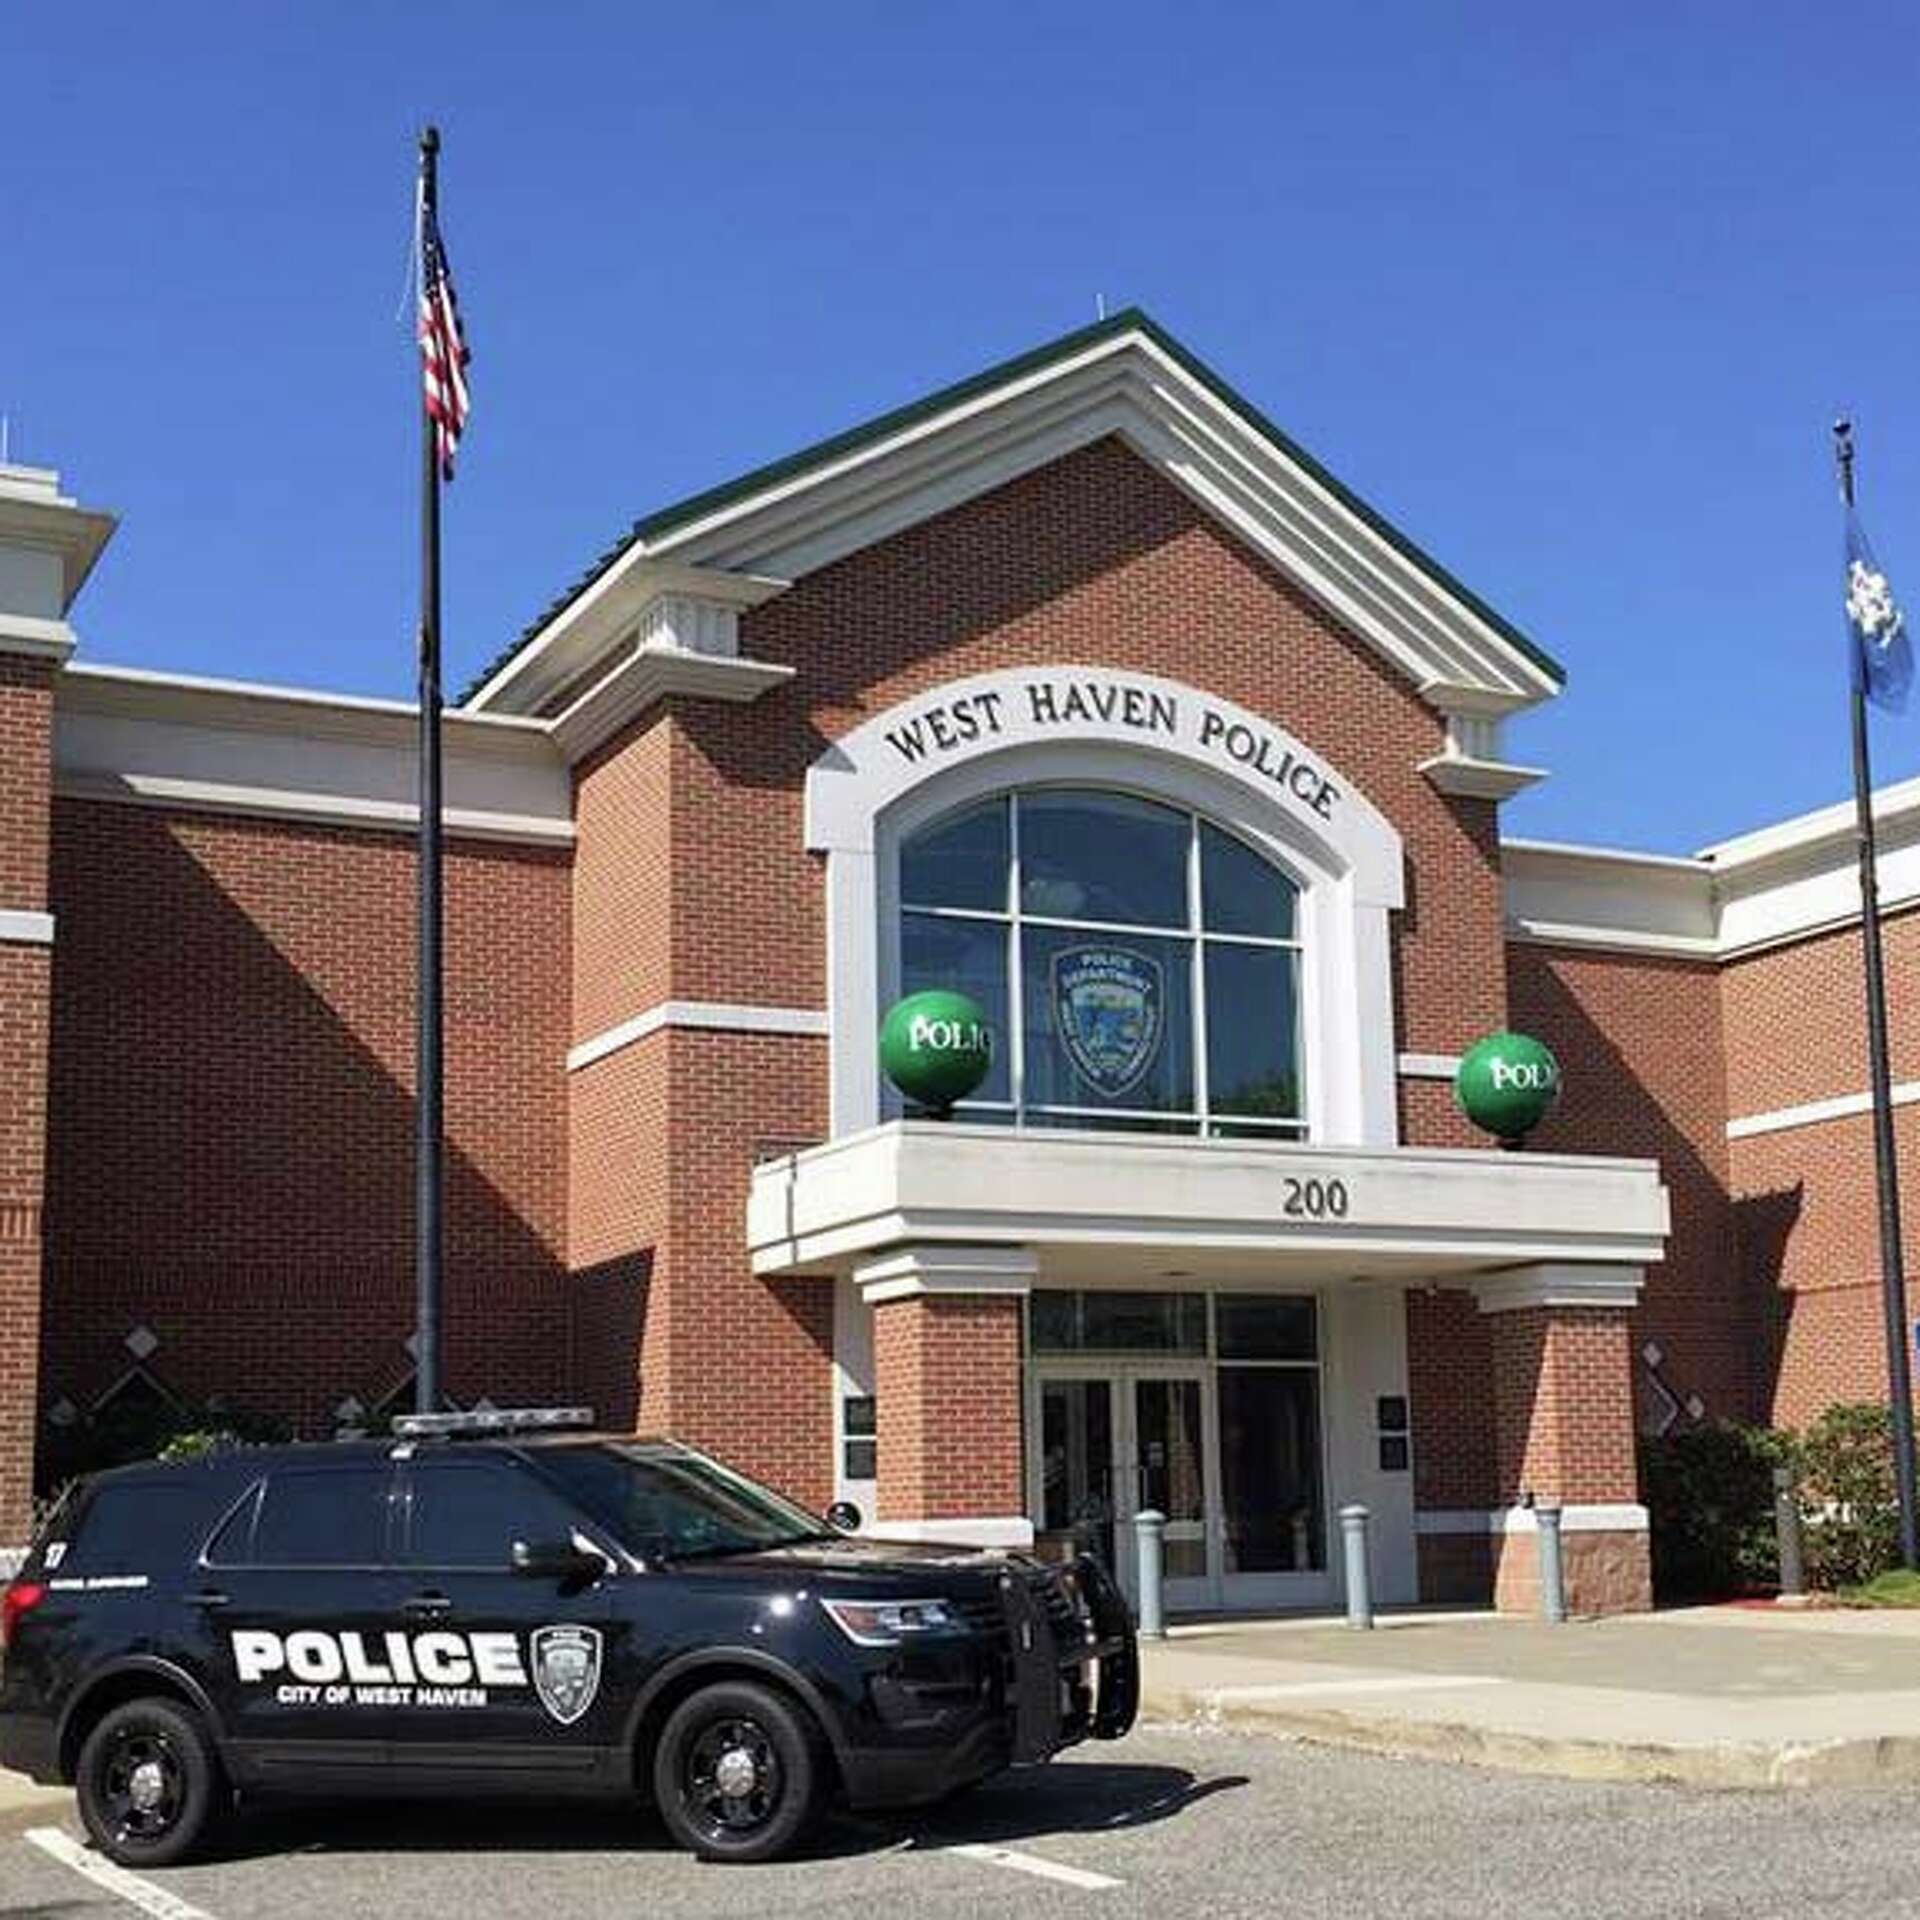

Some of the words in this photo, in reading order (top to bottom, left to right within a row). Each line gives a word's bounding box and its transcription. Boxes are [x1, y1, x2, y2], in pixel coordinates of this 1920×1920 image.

[886, 693, 1003, 765] WEST
[1027, 683, 1178, 735] HAVEN
[1199, 711, 1342, 822] POLICE
[1283, 1178, 1348, 1218] 200
[231, 1630, 528, 1685] POLICE
[276, 1685, 321, 1704] CITY
[325, 1686, 351, 1705] OF
[355, 1687, 412, 1706] WEST
[416, 1688, 488, 1707] HAVEN
